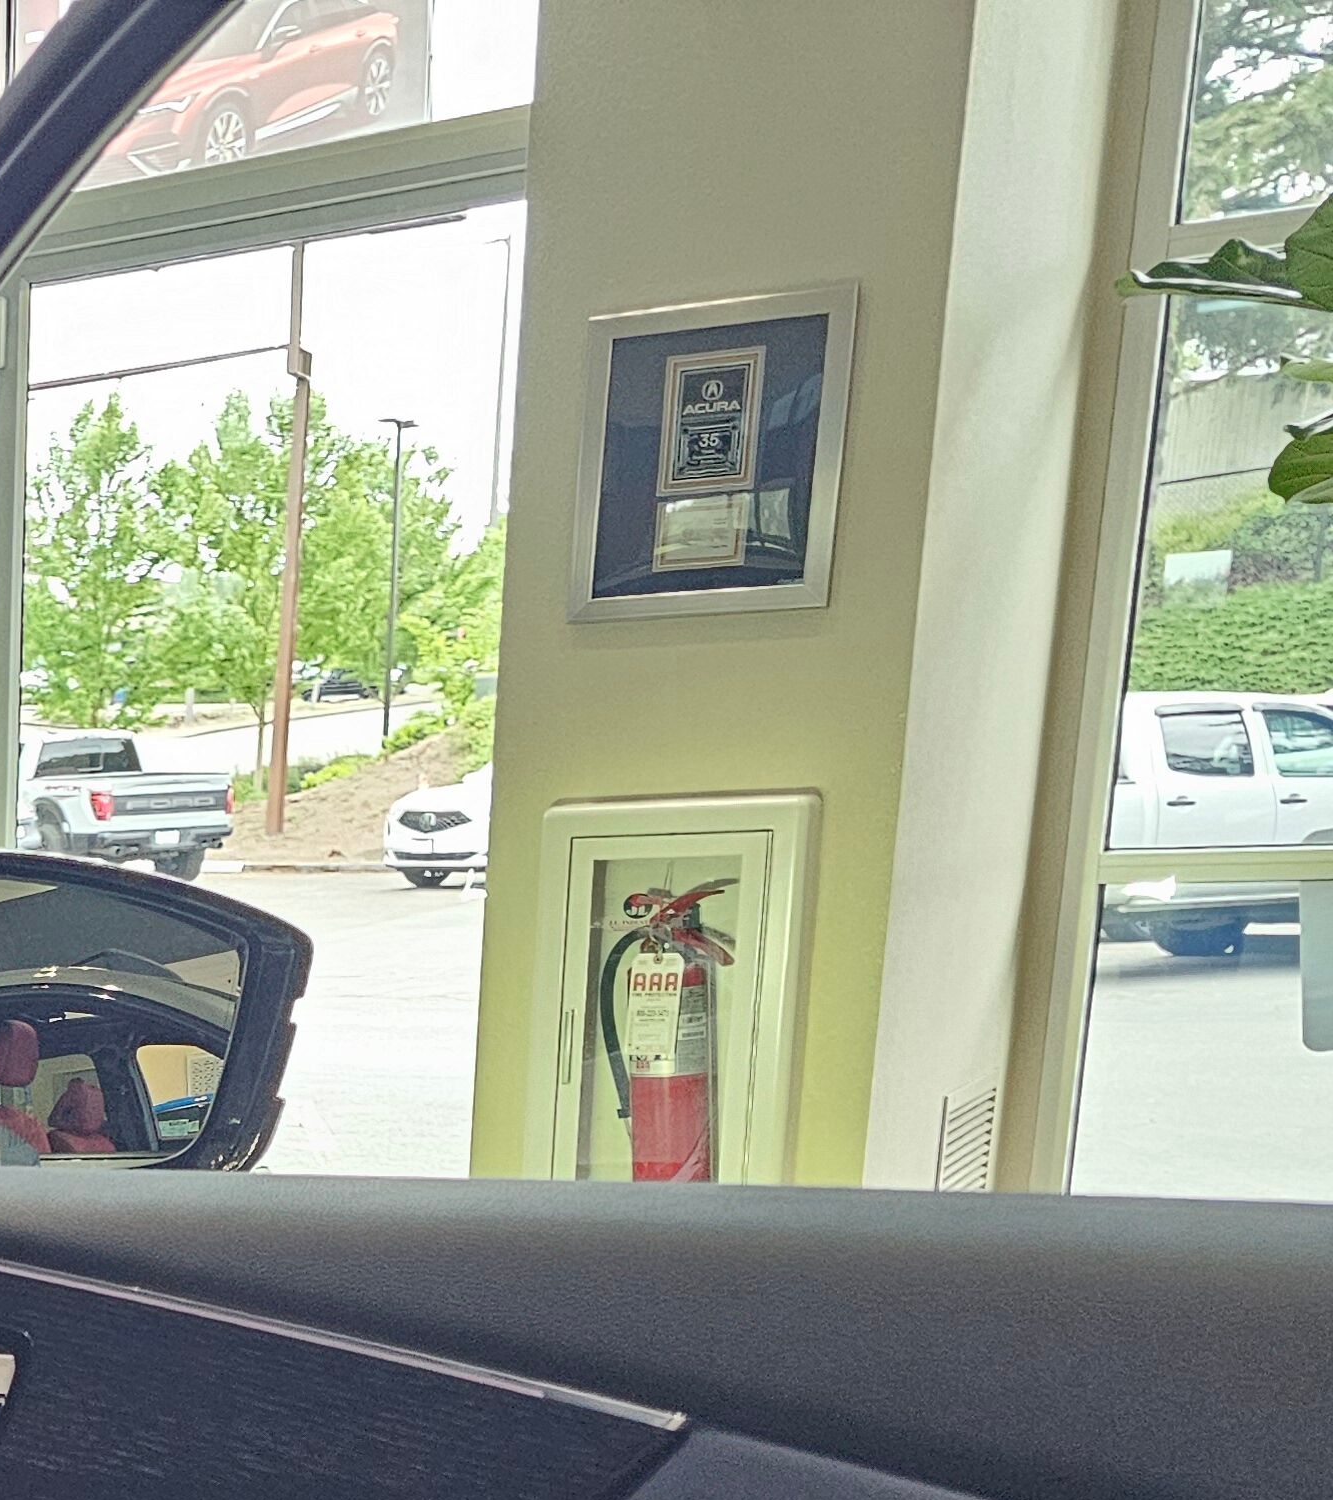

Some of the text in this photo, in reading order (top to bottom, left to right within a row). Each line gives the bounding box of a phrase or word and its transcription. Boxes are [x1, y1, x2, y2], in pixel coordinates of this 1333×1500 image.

[682, 400, 742, 416] ACURA
[698, 432, 720, 448] 35
[126, 797, 215, 811] FORD
